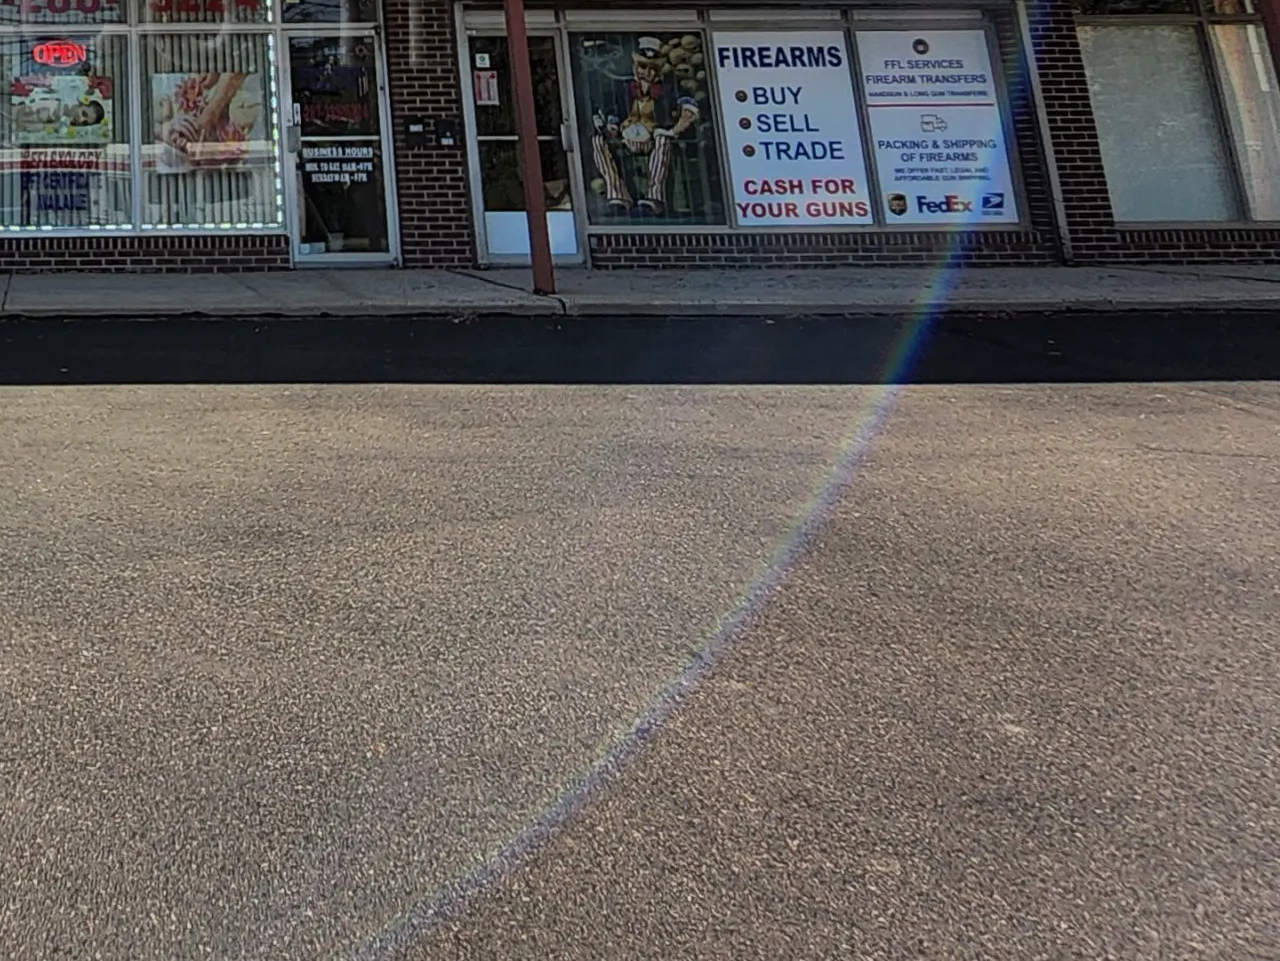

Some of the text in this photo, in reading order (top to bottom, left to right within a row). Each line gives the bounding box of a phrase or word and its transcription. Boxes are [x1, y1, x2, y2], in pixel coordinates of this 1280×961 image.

[33, 41, 87, 68] OPEN
[717, 46, 842, 68] FIREARMS
[884, 59, 964, 69] FFL SERVICES
[866, 74, 987, 84] FIREARM TRANSFERS
[752, 86, 803, 105] BUY
[756, 114, 819, 133] SELL
[302, 146, 373, 158] BUSINESS HOURS
[758, 141, 846, 160] TRADE
[878, 139, 997, 149] PACKING & SHIPPING
[21, 150, 102, 169] REFLEXOLOGY
[900, 152, 978, 162] OF FIREARMS
[743, 179, 856, 195] CASH FOR
[736, 202, 800, 219] YOUR
[806, 201, 869, 218] GUNS
[916, 194, 974, 214] FedEx
